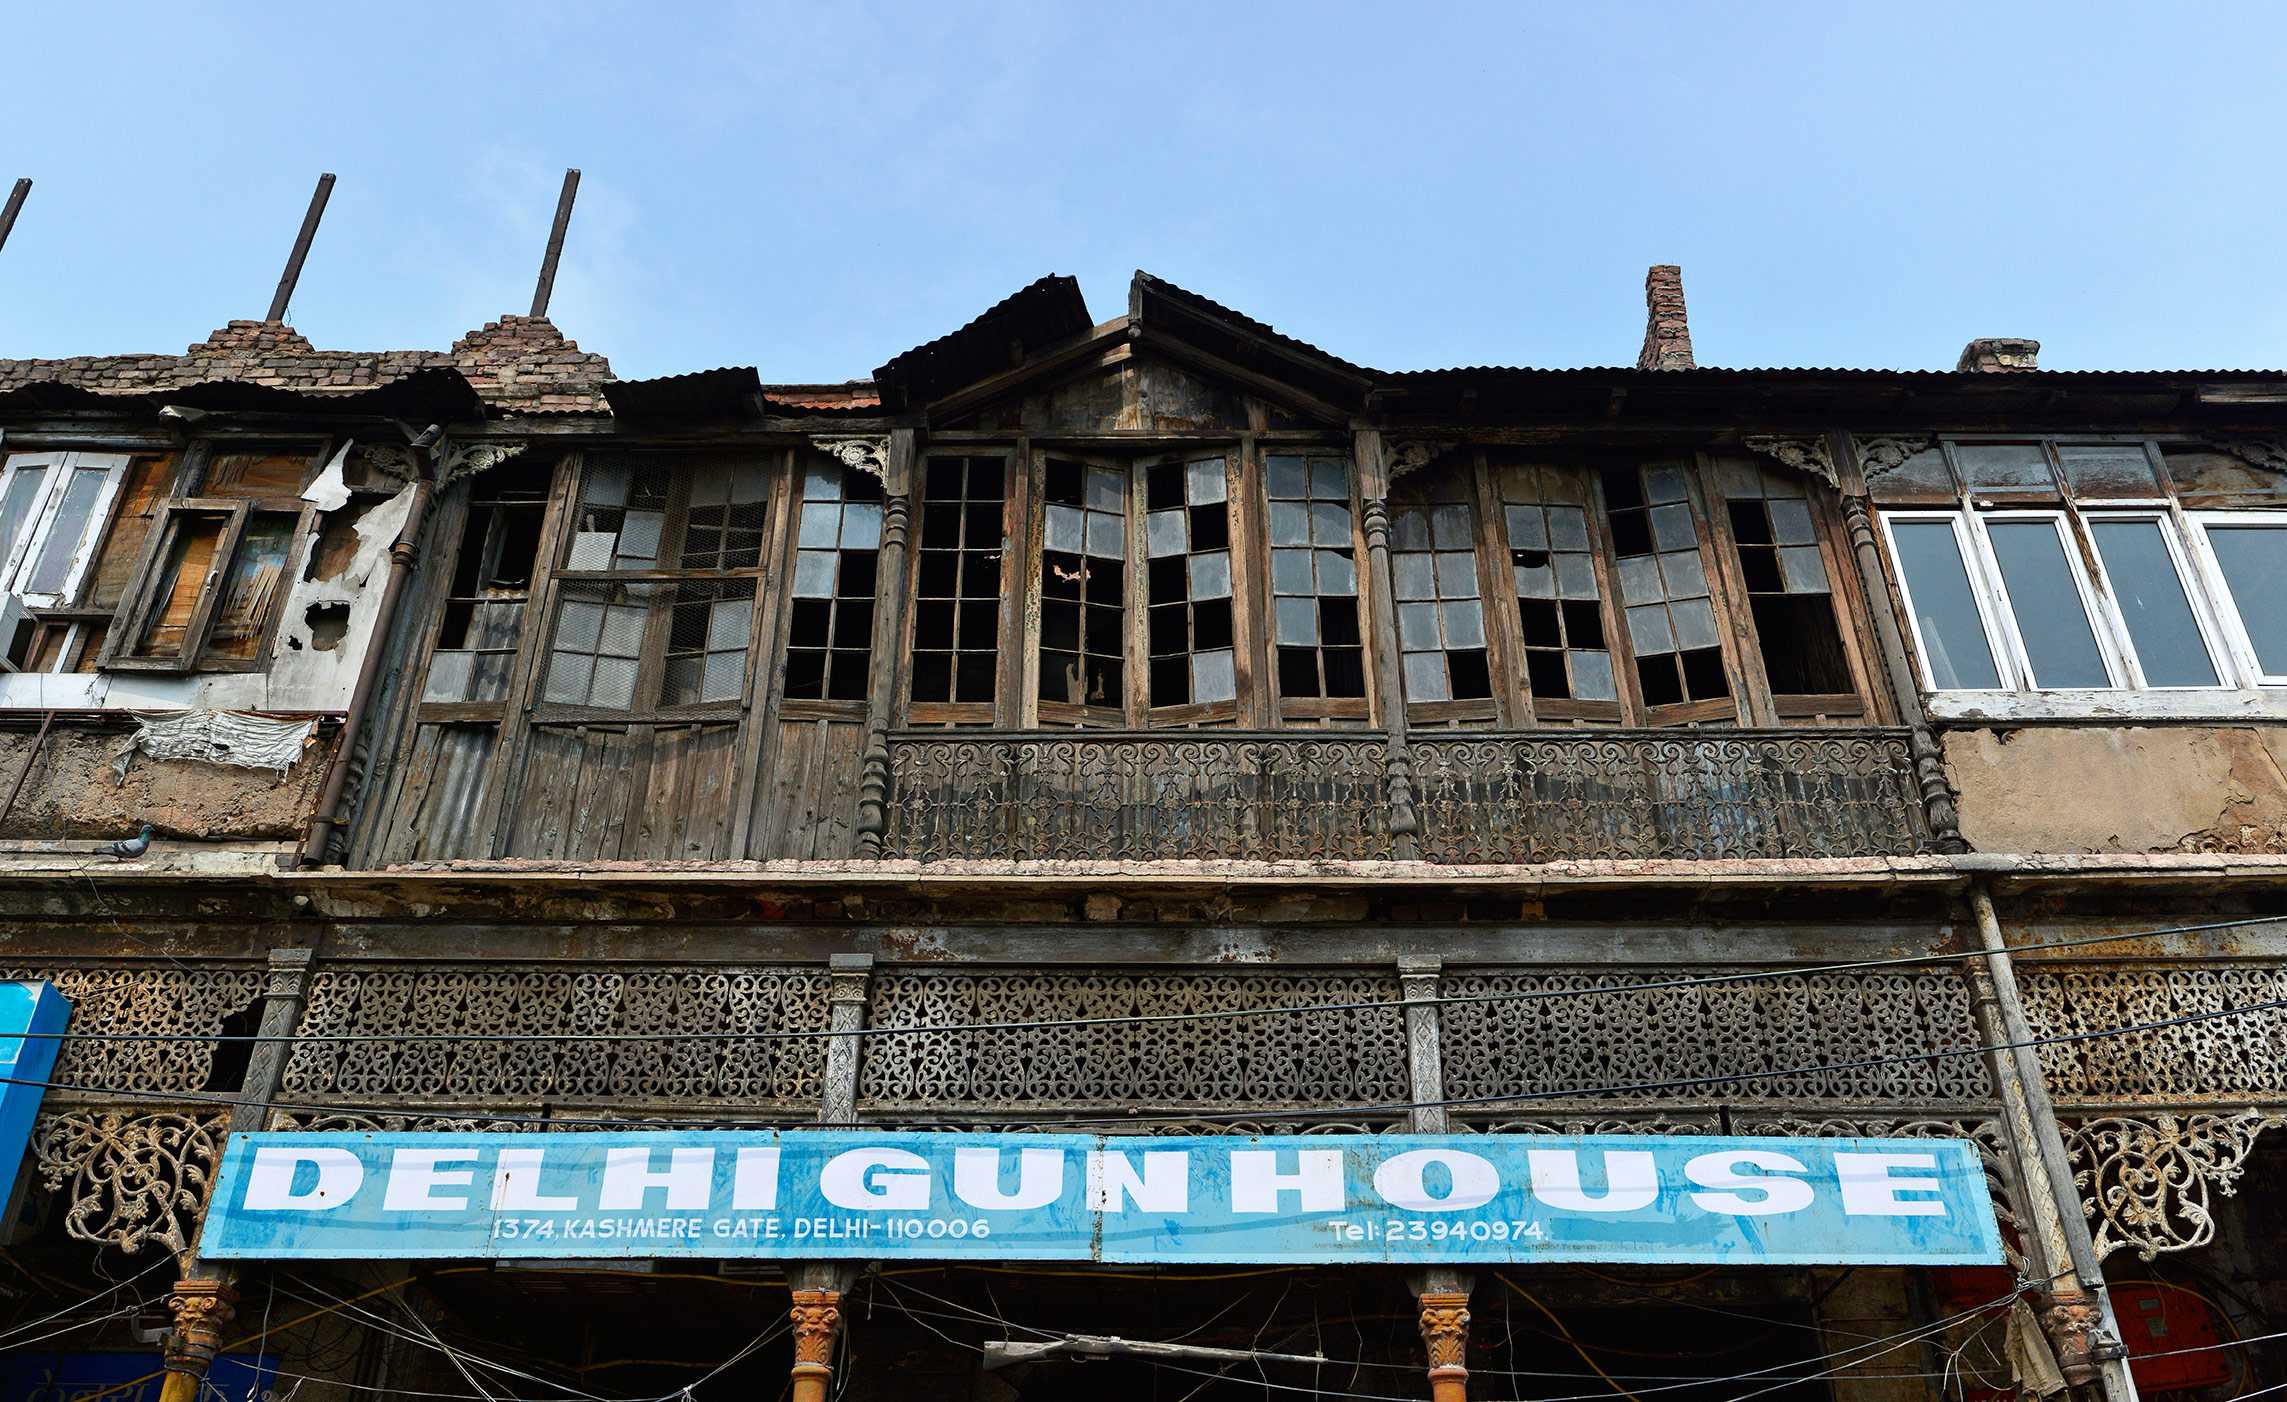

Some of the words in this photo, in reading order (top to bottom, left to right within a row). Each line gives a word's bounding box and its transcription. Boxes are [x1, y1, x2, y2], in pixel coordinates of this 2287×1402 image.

[242, 1146, 782, 1212] DELHI
[818, 1146, 1190, 1213] GUN
[1229, 1148, 1948, 1217] HOUSE
[712, 1217, 787, 1241] GATE,
